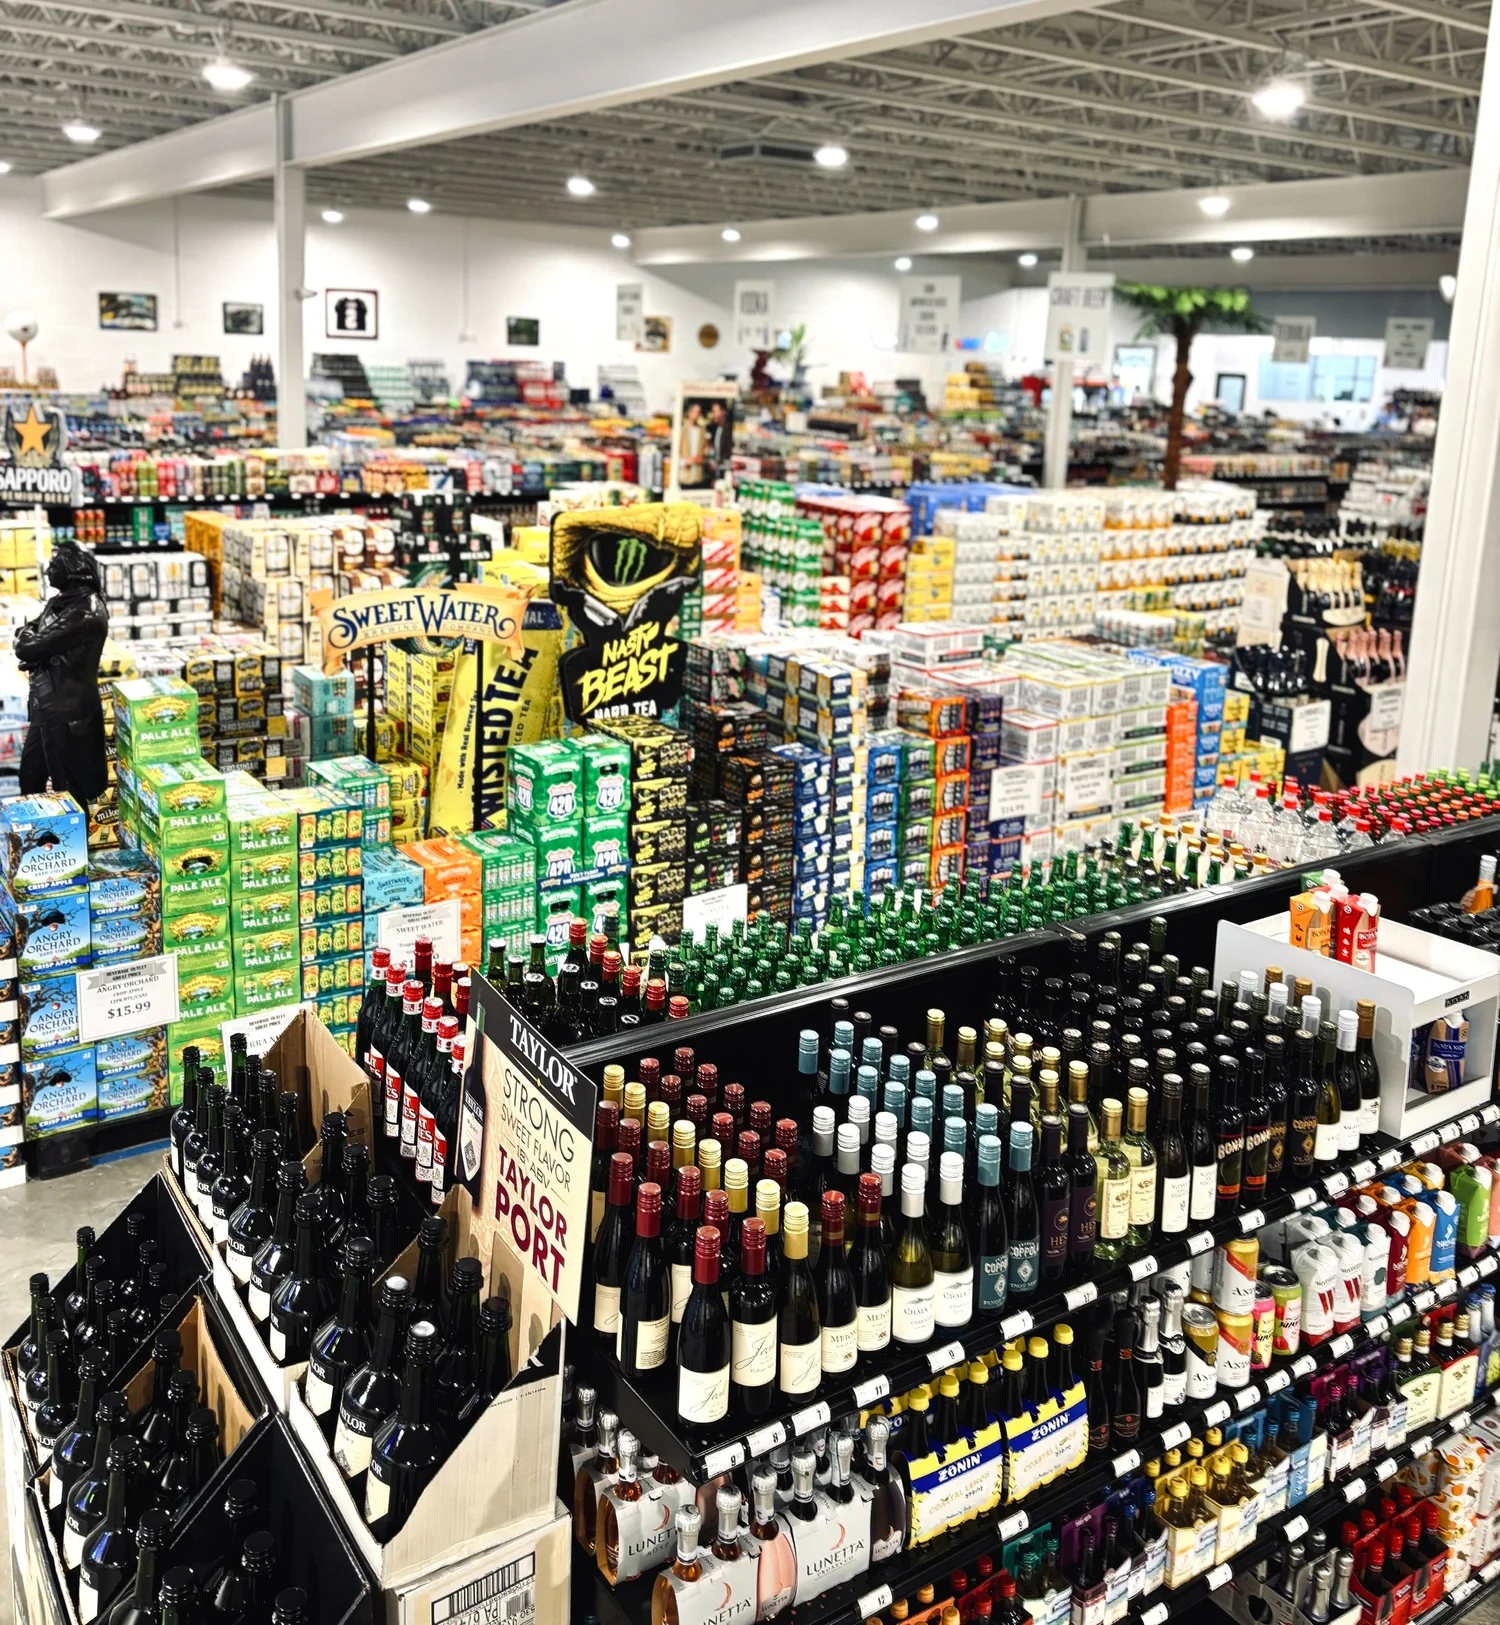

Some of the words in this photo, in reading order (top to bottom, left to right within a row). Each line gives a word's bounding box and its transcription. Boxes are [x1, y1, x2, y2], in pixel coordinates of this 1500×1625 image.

[364, 623, 418, 639] BREWING
[602, 621, 659, 666] NASTY
[575, 643, 679, 715] BEAST
[519, 699, 531, 718] TEA
[633, 699, 657, 716] TEA
[464, 704, 477, 733] Brewed
[141, 729, 168, 742] PALE
[171, 727, 191, 738] ALE
[461, 735, 470, 752] Real
[480, 707, 514, 818] WISTED
[457, 775, 465, 790] Made
[518, 787, 532, 804] 420
[600, 791, 623, 807] 420
[550, 800, 575, 815] 420
[170, 816, 199, 828] PALE
[201, 813, 222, 824] ALE
[241, 840, 267, 850] PALE
[270, 836, 290, 846] ALE
[30, 850, 67, 864] ANGRY
[21, 858, 77, 874] ORCHARD
[28, 880, 49, 891] CRISP
[49, 879, 73, 888] APPLE
[103, 885, 130, 894] ANGRY
[170, 881, 199, 893] PALE
[200, 878, 222, 889] ALE
[242, 879, 269, 890] PALE
[271, 875, 290, 886] ALE
[98, 890, 136, 902] ORCHARD
[96, 907, 117, 916] CRISP
[117, 904, 139, 912] APPLE
[243, 918, 270, 929] PALE
[271, 913, 291, 924] ALE
[396, 925, 420, 934] SWEET
[421, 920, 444, 929] WATER
[35, 930, 73, 945] ANGRY
[100, 930, 137, 942] ORCHARD
[105, 926, 130, 935] ANGRY
[27, 937, 81, 954] ORCHARD
[98, 947, 118, 956] CRISP
[119, 944, 140, 953] APPLE
[174, 944, 202, 956] PALE
[204, 940, 225, 951] ALE
[33, 961, 55, 971] CRISP
[56, 958, 77, 967] APPLE
[245, 956, 272, 967] PALE
[273, 951, 293, 962] ALE
[97, 983, 123, 993] ANGRY
[124, 976, 159, 988] ORCHARD
[246, 993, 273, 1004] PALE
[274, 988, 294, 999] ALE
[37, 1008, 75, 1023] ANGRY
[108, 1001, 151, 1019] $15.99
[205, 1002, 227, 1014] ALE
[29, 1016, 79, 1032] ORCHAR
[35, 1040, 57, 1050] CRISP
[57, 1036, 79, 1047] APPLE
[110, 1045, 136, 1055] ANGRY
[105, 1049, 142, 1061] ORCHARD
[510, 1013, 577, 1105] TAYLOR
[103, 1067, 123, 1076] CRISP
[124, 1062, 146, 1072] APPLE
[42, 1086, 78, 1100] ANGRY
[107, 1088, 144, 1101] ORCHARD
[112, 1083, 138, 1093] ANGRY
[33, 1092, 87, 1111] ORCHARD
[105, 1105, 125, 1115] CRISP
[126, 1101, 147, 1111] APPLE
[465, 1092, 483, 1119] TAYLOR
[39, 1118, 61, 1129] CRISP
[61, 1112, 83, 1122] APPLE
[503, 1068, 575, 1163] STRONG
[501, 1106, 532, 1146] SWEET
[533, 1140, 571, 1194] FLAVOR
[529, 1159, 551, 1189] ABV
[499, 1143, 568, 1251] TAYLOR
[495, 1180, 565, 1294] PORT
[1031, 1412, 1069, 1441] ZONIN
[938, 1453, 982, 1482] ZONIN
[628, 1527, 677, 1556] LUNETT
[806, 1539, 865, 1577] LUNETTA
[817, 1555, 854, 1578] PROSECCO
[761, 1595, 788, 1612] LUNETTA
